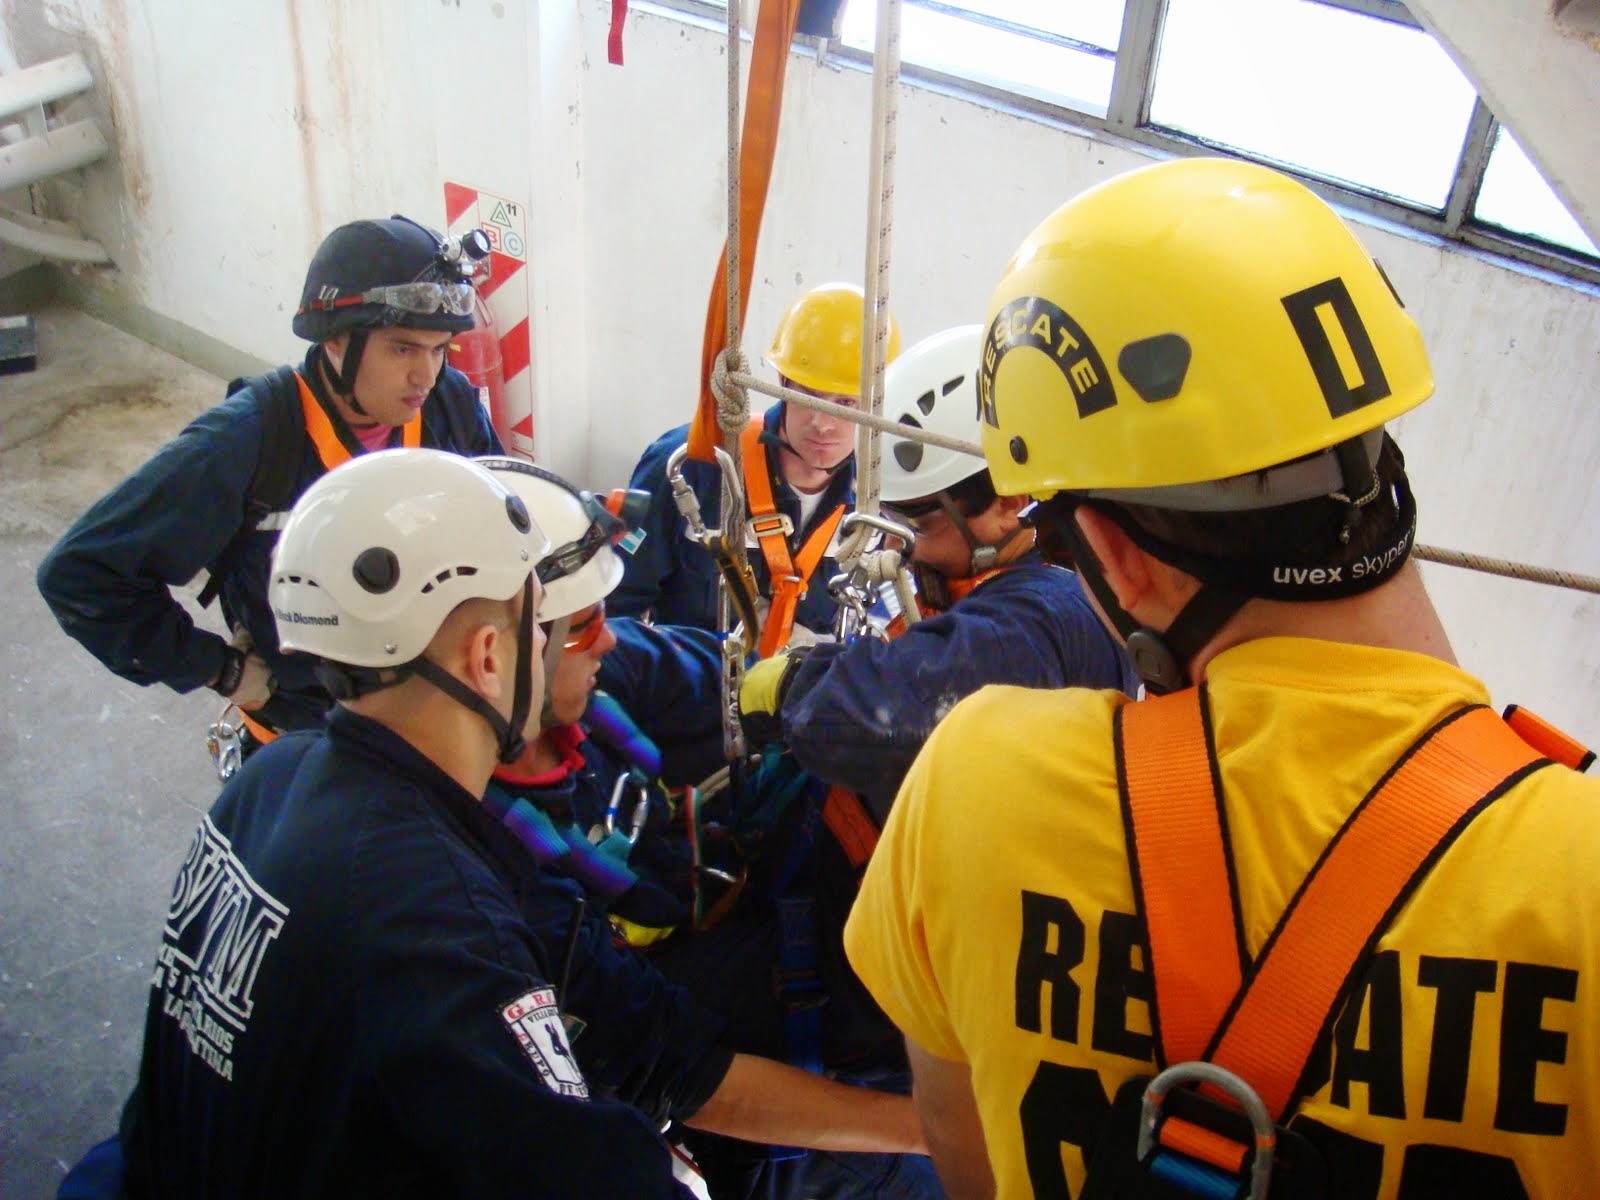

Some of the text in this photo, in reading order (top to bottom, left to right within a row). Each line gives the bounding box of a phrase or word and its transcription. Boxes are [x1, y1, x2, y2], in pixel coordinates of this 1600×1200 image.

[982, 308, 1099, 406] RESCATE
[1273, 566, 1342, 584] uvex
[293, 612, 339, 626] Diamond
